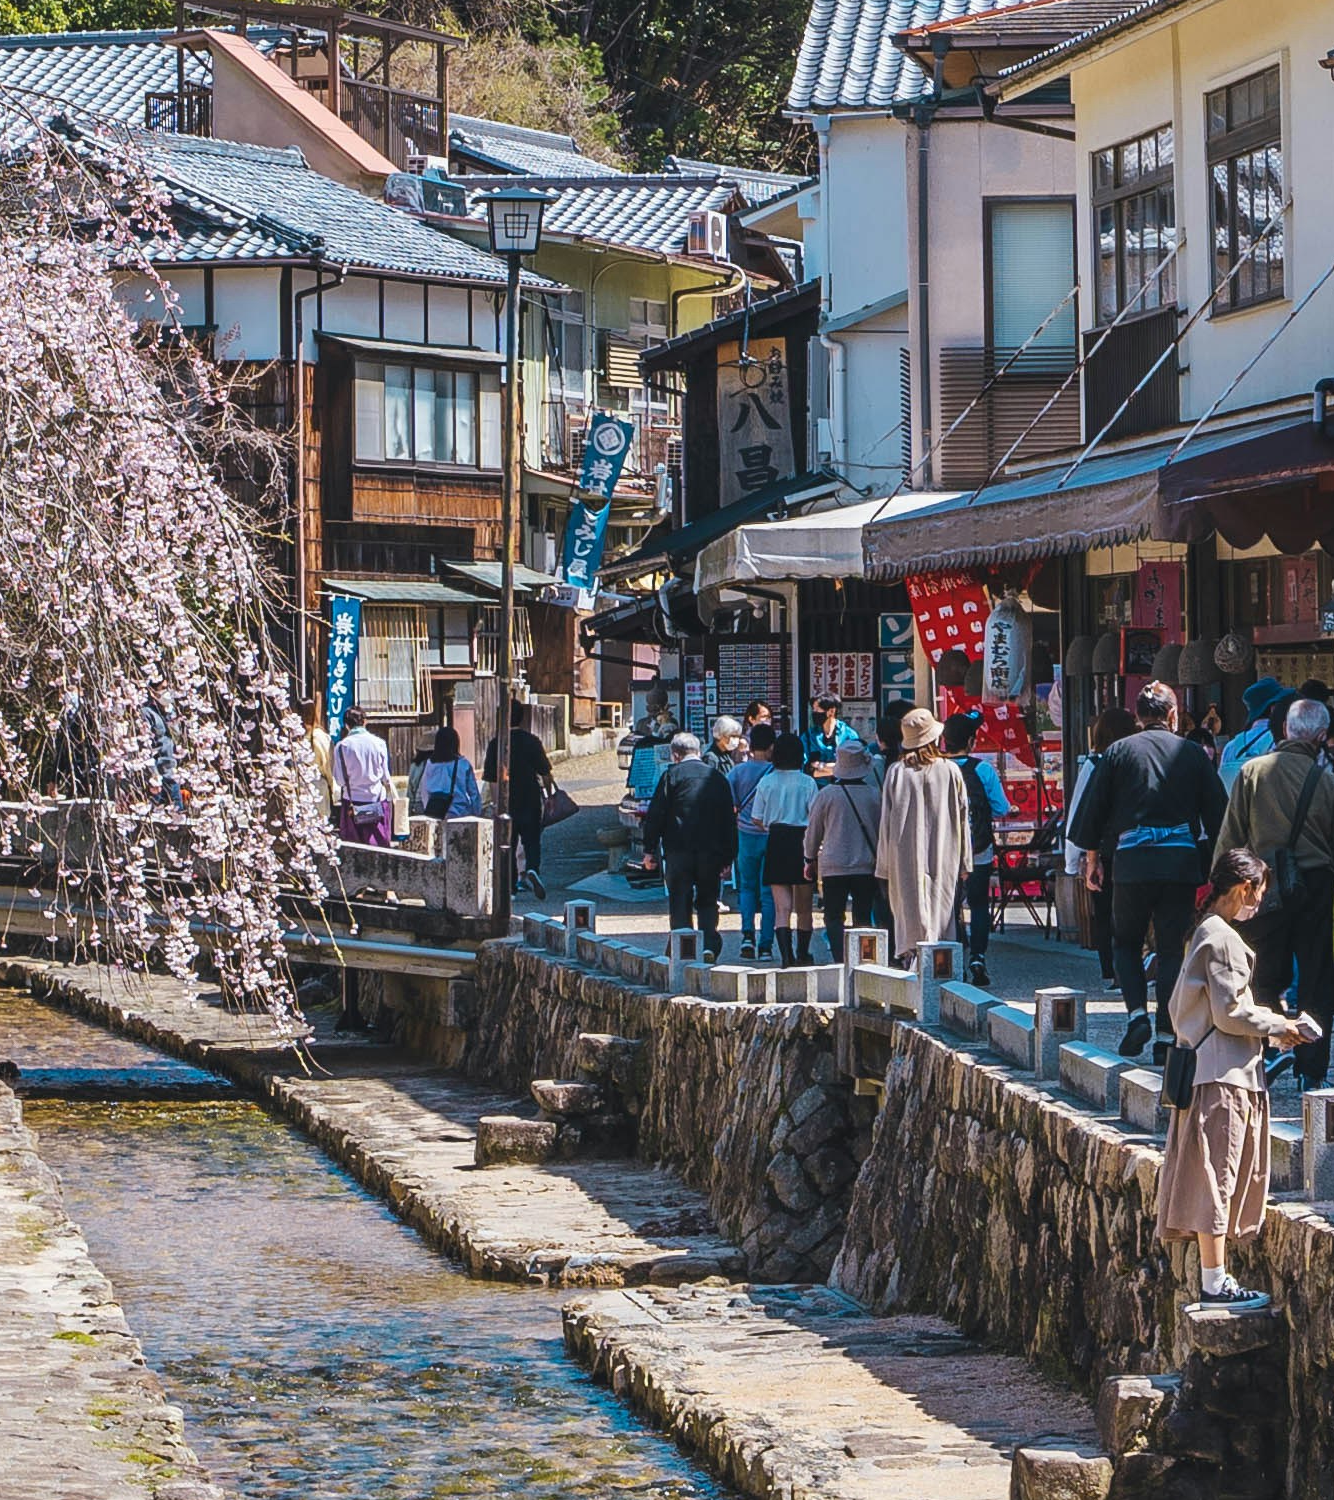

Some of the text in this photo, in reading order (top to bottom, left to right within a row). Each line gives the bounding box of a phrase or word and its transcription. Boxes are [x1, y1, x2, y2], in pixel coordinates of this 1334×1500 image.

[729, 392, 783, 491] 八昌
[329, 612, 355, 737] 岩村もみじ屋
[990, 621, 1013, 690] やまむら商店
